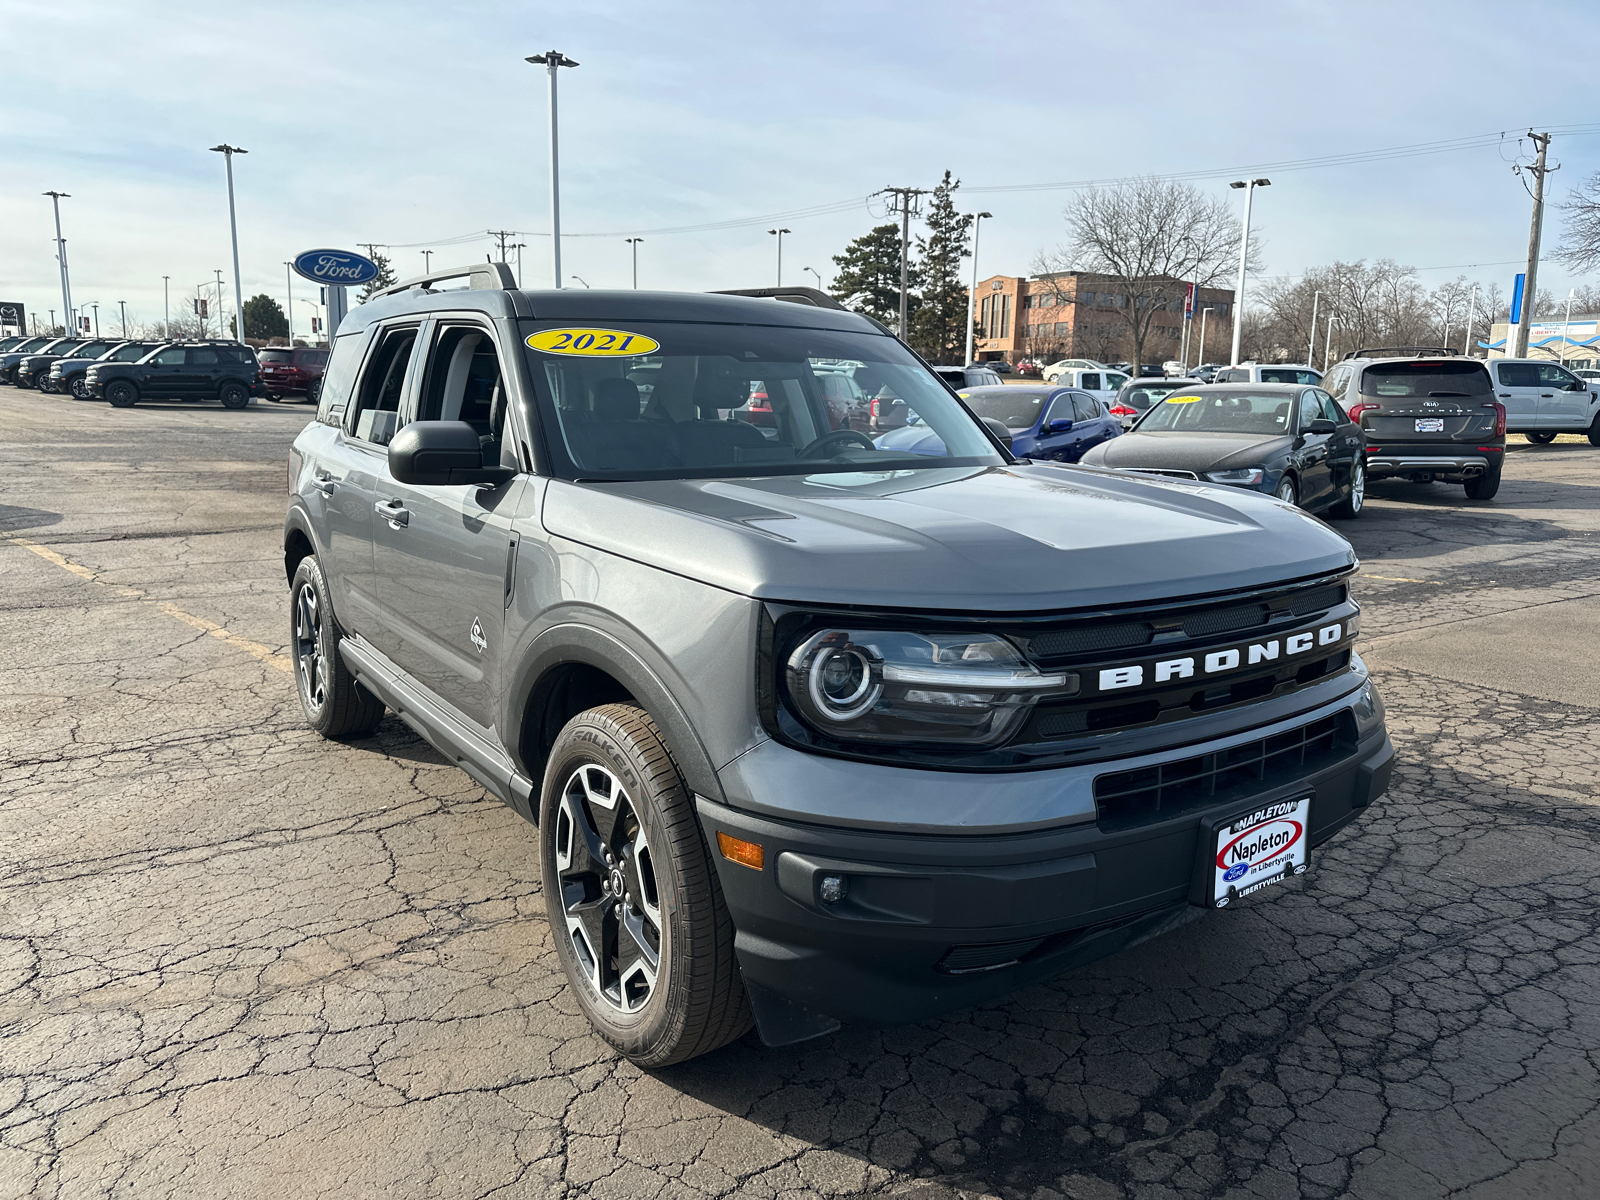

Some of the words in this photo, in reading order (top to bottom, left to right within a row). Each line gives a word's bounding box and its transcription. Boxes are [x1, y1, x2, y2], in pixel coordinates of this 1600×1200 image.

[314, 255, 363, 279] Ford
[549, 333, 635, 351] 2021
[1099, 623, 1342, 691] BRONCO
[573, 730, 638, 789] FALKEN
[1239, 801, 1294, 831] NAPLETON
[1231, 830, 1289, 863] Napleton
[1227, 866, 1245, 880] Ford
[1250, 865, 1257, 875] in
[1258, 853, 1295, 872] Libertyville
[1238, 873, 1285, 898] LIBERTYVILLE
